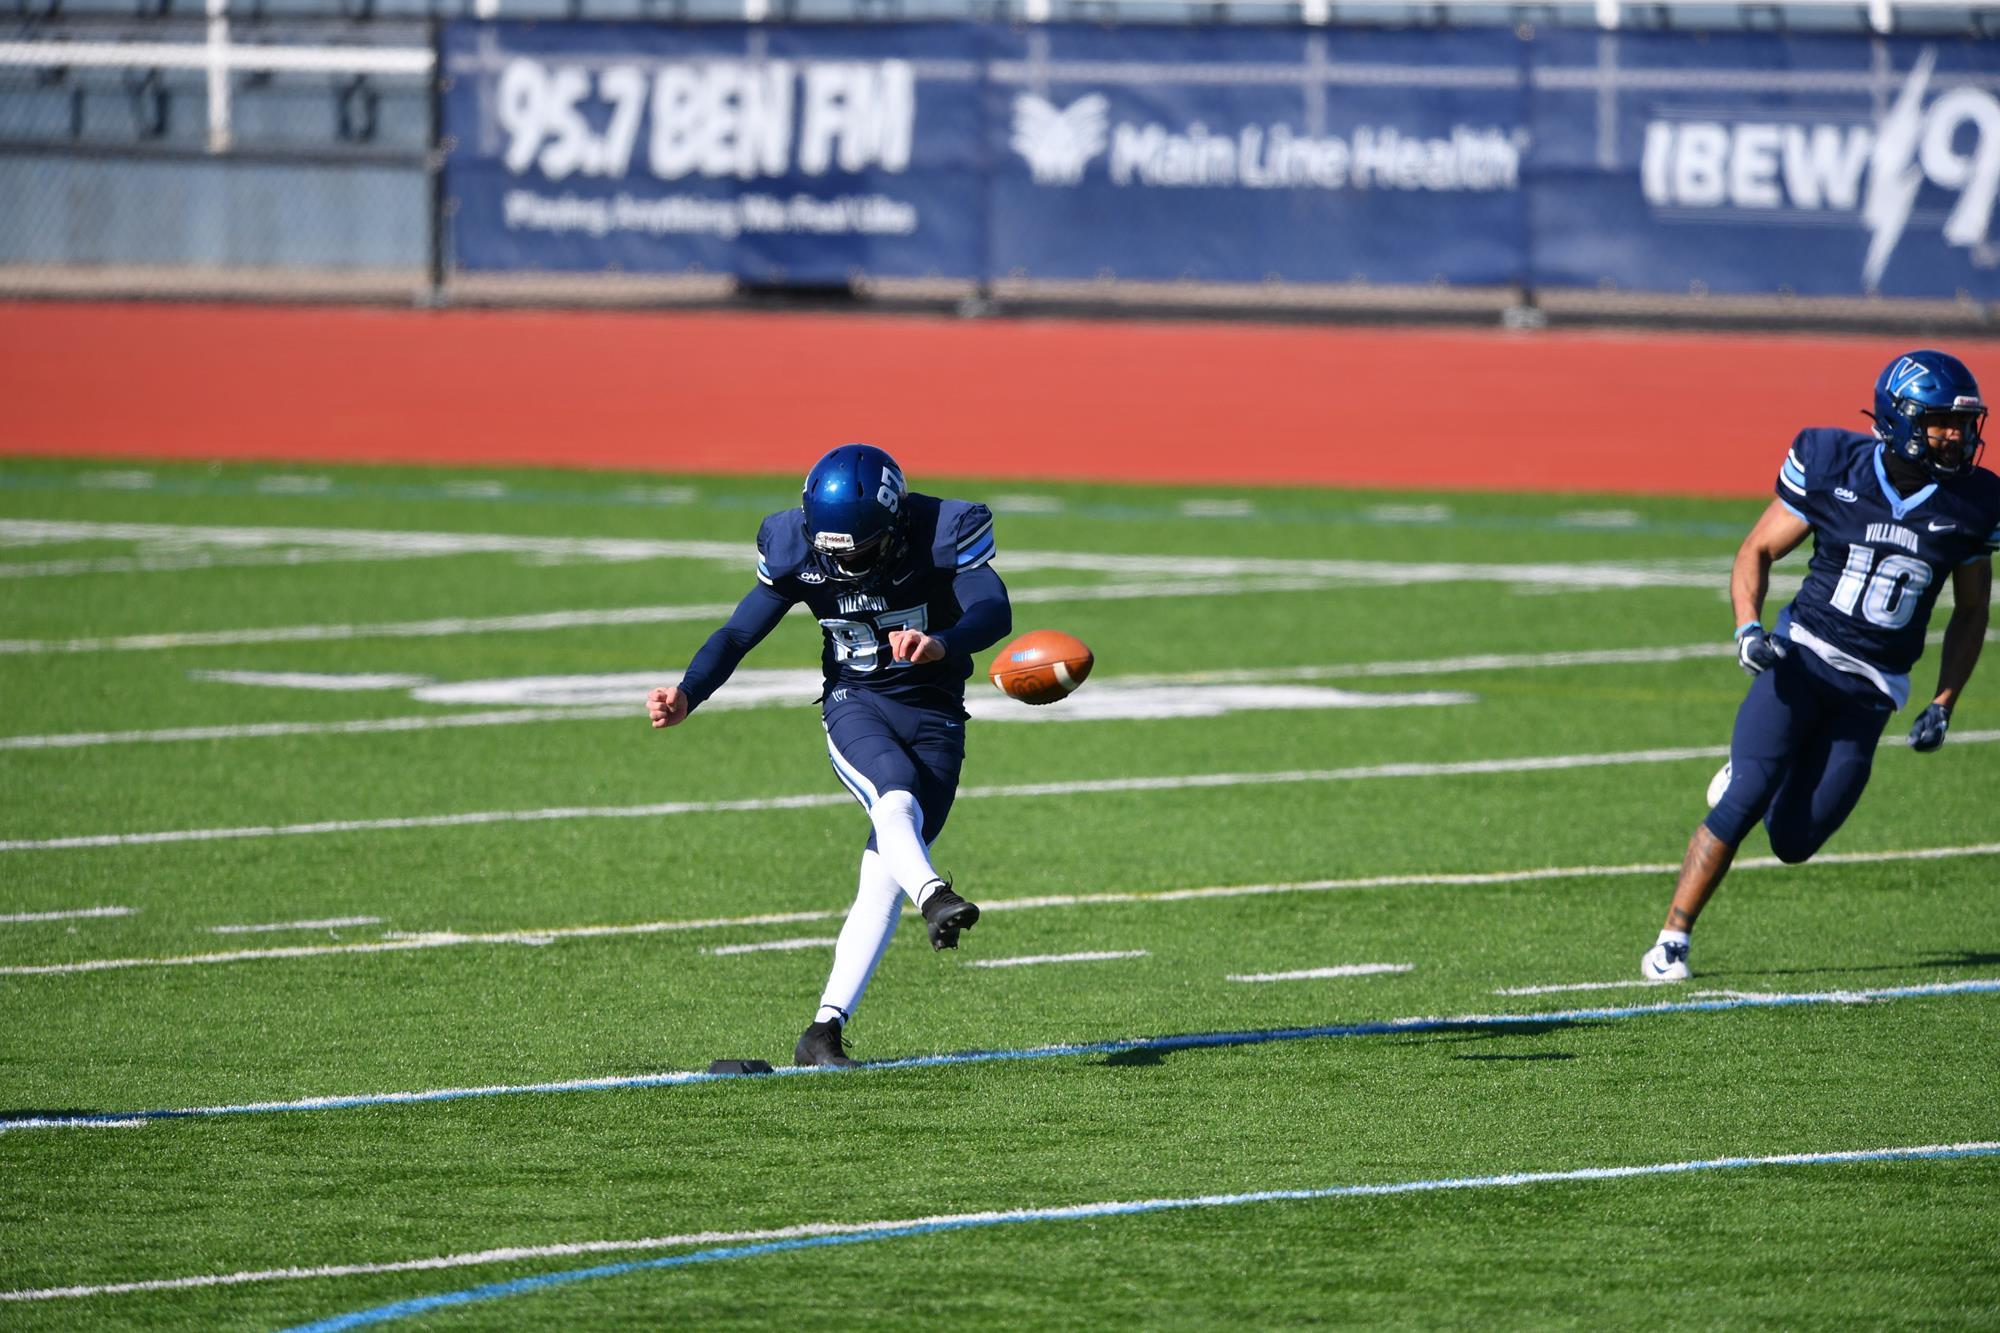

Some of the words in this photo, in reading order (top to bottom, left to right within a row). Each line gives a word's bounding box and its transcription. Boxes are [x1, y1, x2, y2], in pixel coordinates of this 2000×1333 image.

[501, 58, 647, 179] 95.7
[649, 61, 797, 180] BEN
[800, 57, 915, 176] FM
[1109, 121, 1237, 187] Main
[1239, 121, 1349, 189] Line
[1351, 122, 1519, 191] Health
[1641, 120, 1872, 210] IBEW
[877, 466, 904, 513] 97
[1834, 487, 1855, 499] CAA
[1865, 523, 1919, 554] VILLANOVA
[800, 572, 822, 581] CAA
[1830, 543, 1933, 629] 10
[837, 594, 889, 614] VILLANOVA
